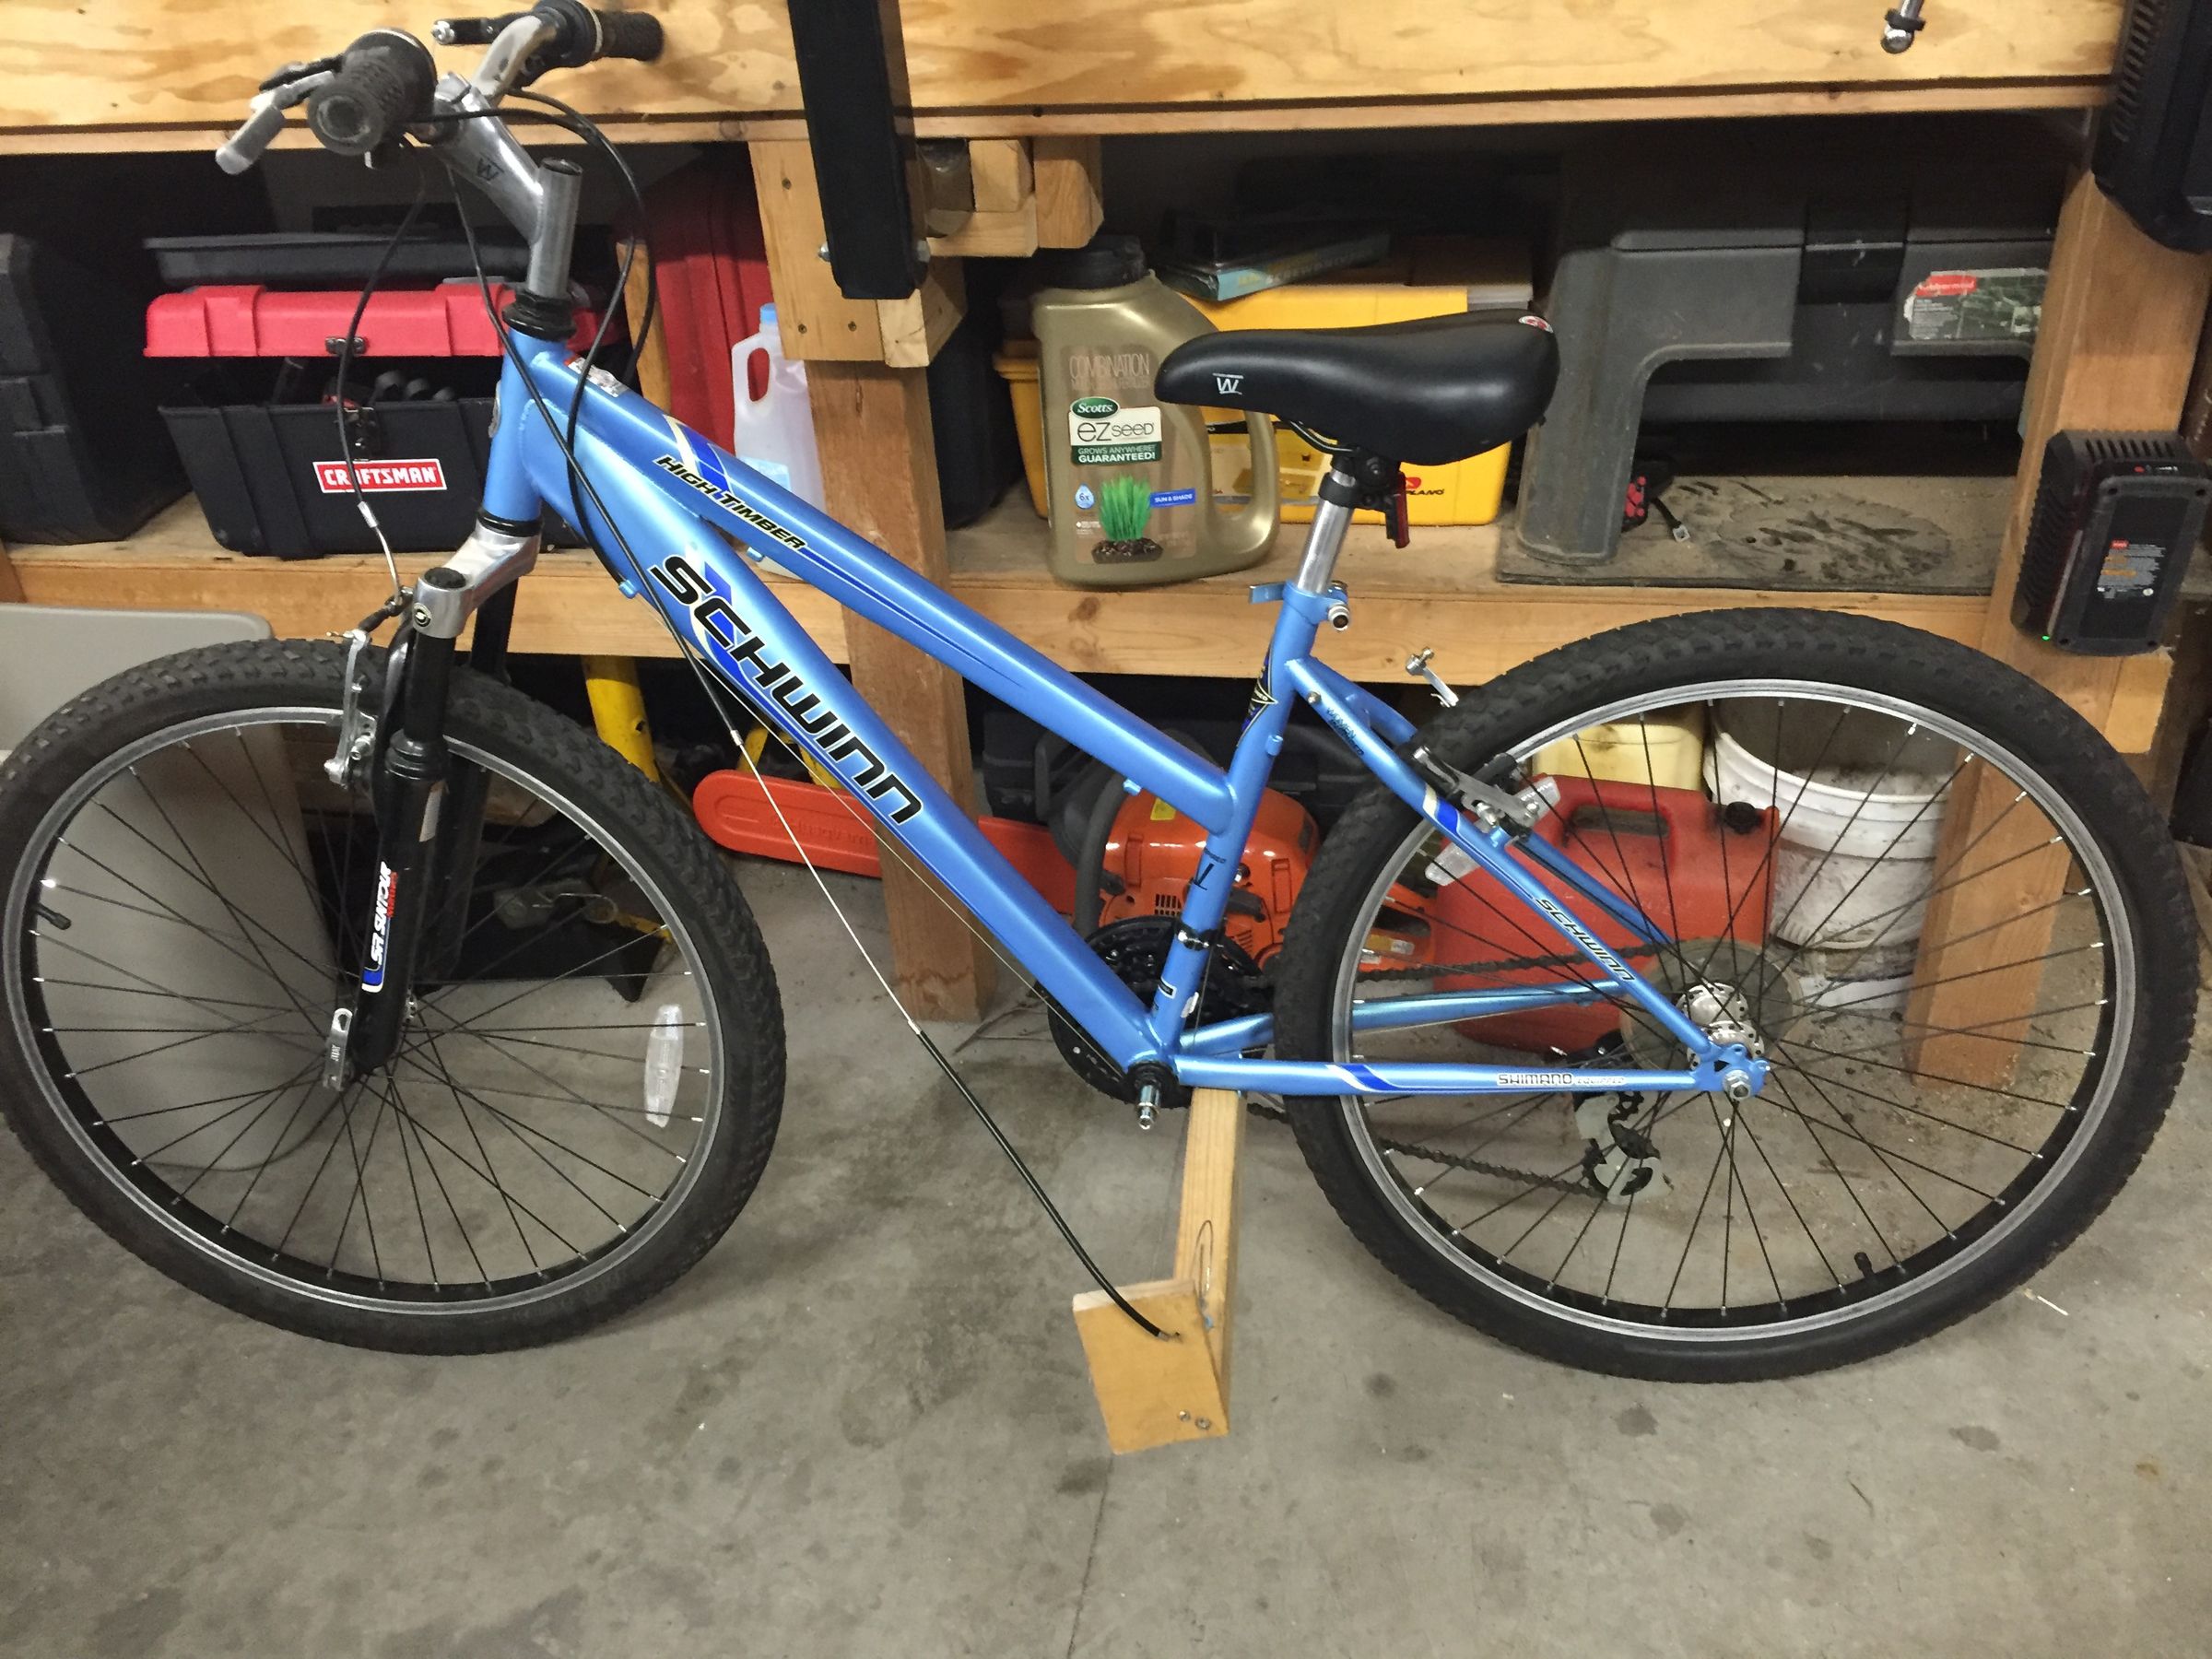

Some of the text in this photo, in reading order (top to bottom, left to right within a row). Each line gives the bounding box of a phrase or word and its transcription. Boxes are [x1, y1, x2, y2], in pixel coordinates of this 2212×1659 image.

[1069, 352, 1150, 379] COMBINATION
[1077, 403, 1114, 414] Scotts
[1077, 446, 1107, 455] GROWS
[1078, 453, 1156, 463] GUARANTEED!
[655, 455, 806, 549] HIGH TIMBER
[1078, 492, 1090, 500] 6x
[649, 556, 922, 825] SCHWINN
[374, 861, 392, 935] SUNTOUR
[1535, 899, 1635, 981] SCHWINN
[1499, 1073, 1572, 1085] SHIMANO
